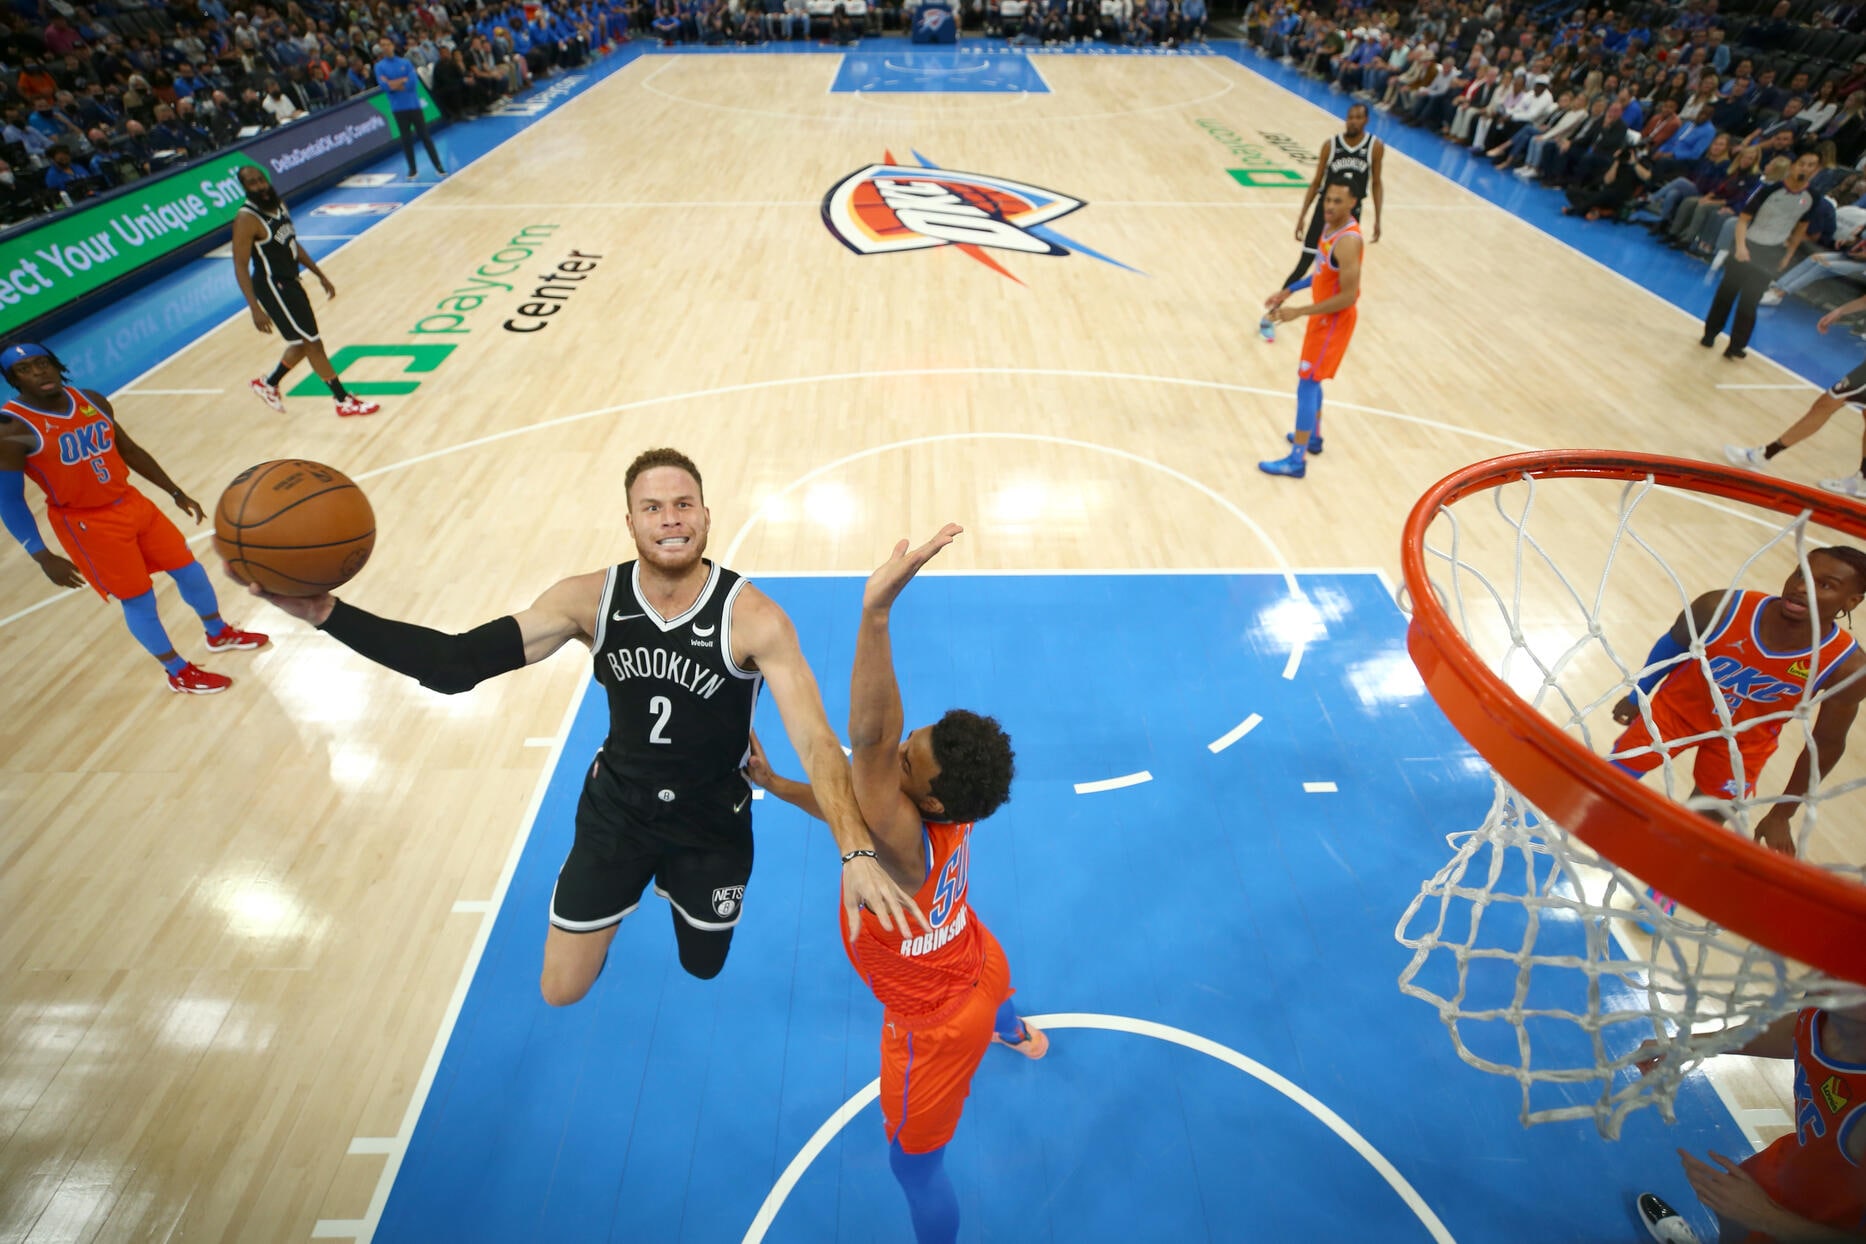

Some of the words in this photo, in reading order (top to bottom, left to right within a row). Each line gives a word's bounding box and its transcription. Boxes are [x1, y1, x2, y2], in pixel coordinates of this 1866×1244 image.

[0, 259, 53, 310] ect
[35, 231, 119, 278] Your
[109, 193, 208, 247] Unique
[408, 224, 560, 334] paycom
[502, 249, 603, 333] center
[58, 420, 112, 465] OKC
[90, 458, 110, 483] 5
[691, 639, 713, 647] Webull
[607, 647, 726, 699] BROOKLYN
[1708, 656, 1803, 703] OKC
[649, 695, 672, 744] 2
[714, 887, 744, 901] NETS
[901, 904, 967, 957] ROBINSON
